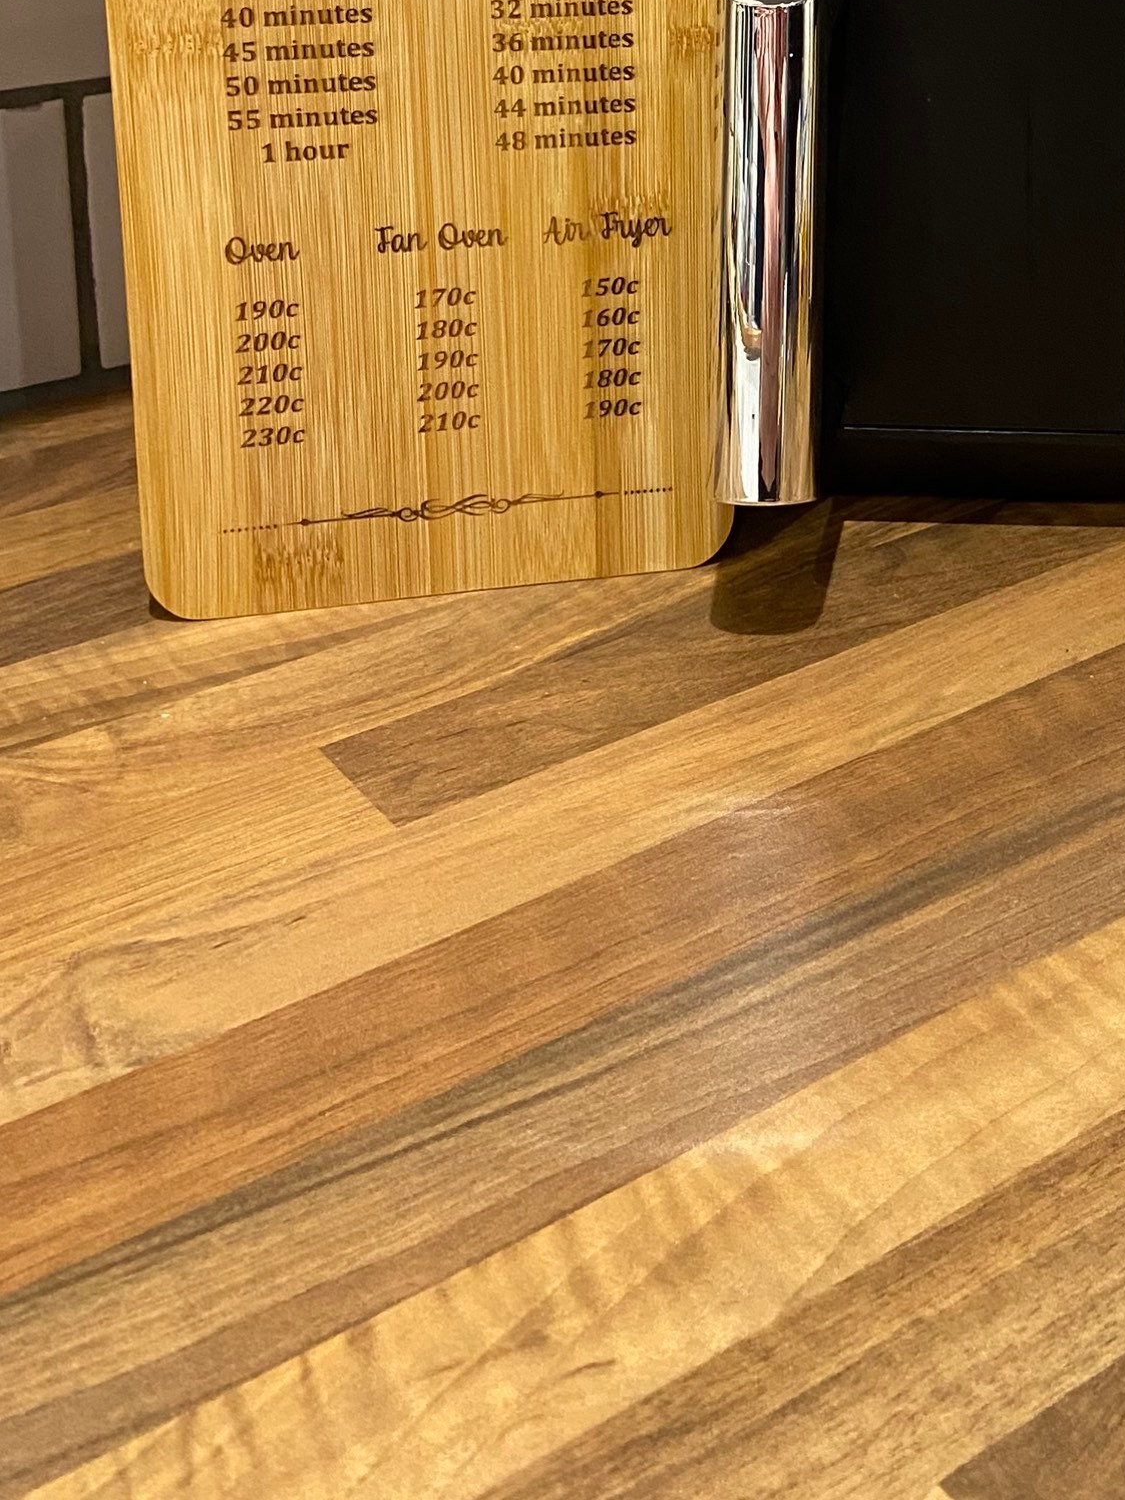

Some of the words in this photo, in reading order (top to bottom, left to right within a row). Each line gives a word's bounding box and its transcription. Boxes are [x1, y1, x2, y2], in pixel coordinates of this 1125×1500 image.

[221, 7, 254, 27] 40
[264, 4, 373, 27] minutes
[223, 42, 256, 63] 45
[266, 39, 375, 61] minutes
[226, 76, 259, 97] 50
[268, 72, 376, 95] minutes
[493, 66, 524, 85] 40
[533, 63, 635, 83] minutes
[494, 99, 526, 118] 44
[534, 95, 636, 116] minutes
[228, 111, 260, 131] 55
[270, 107, 378, 129] minutes
[495, 131, 526, 151] 48
[535, 128, 637, 149] minutes
[262, 143, 275, 163] 1
[286, 141, 350, 162] hour
[375, 226, 427, 254] Fan
[438, 222, 508, 250] Oven
[543, 216, 591, 245] Air
[600, 211, 673, 248] Fryer
[224, 237, 300, 265] Oven
